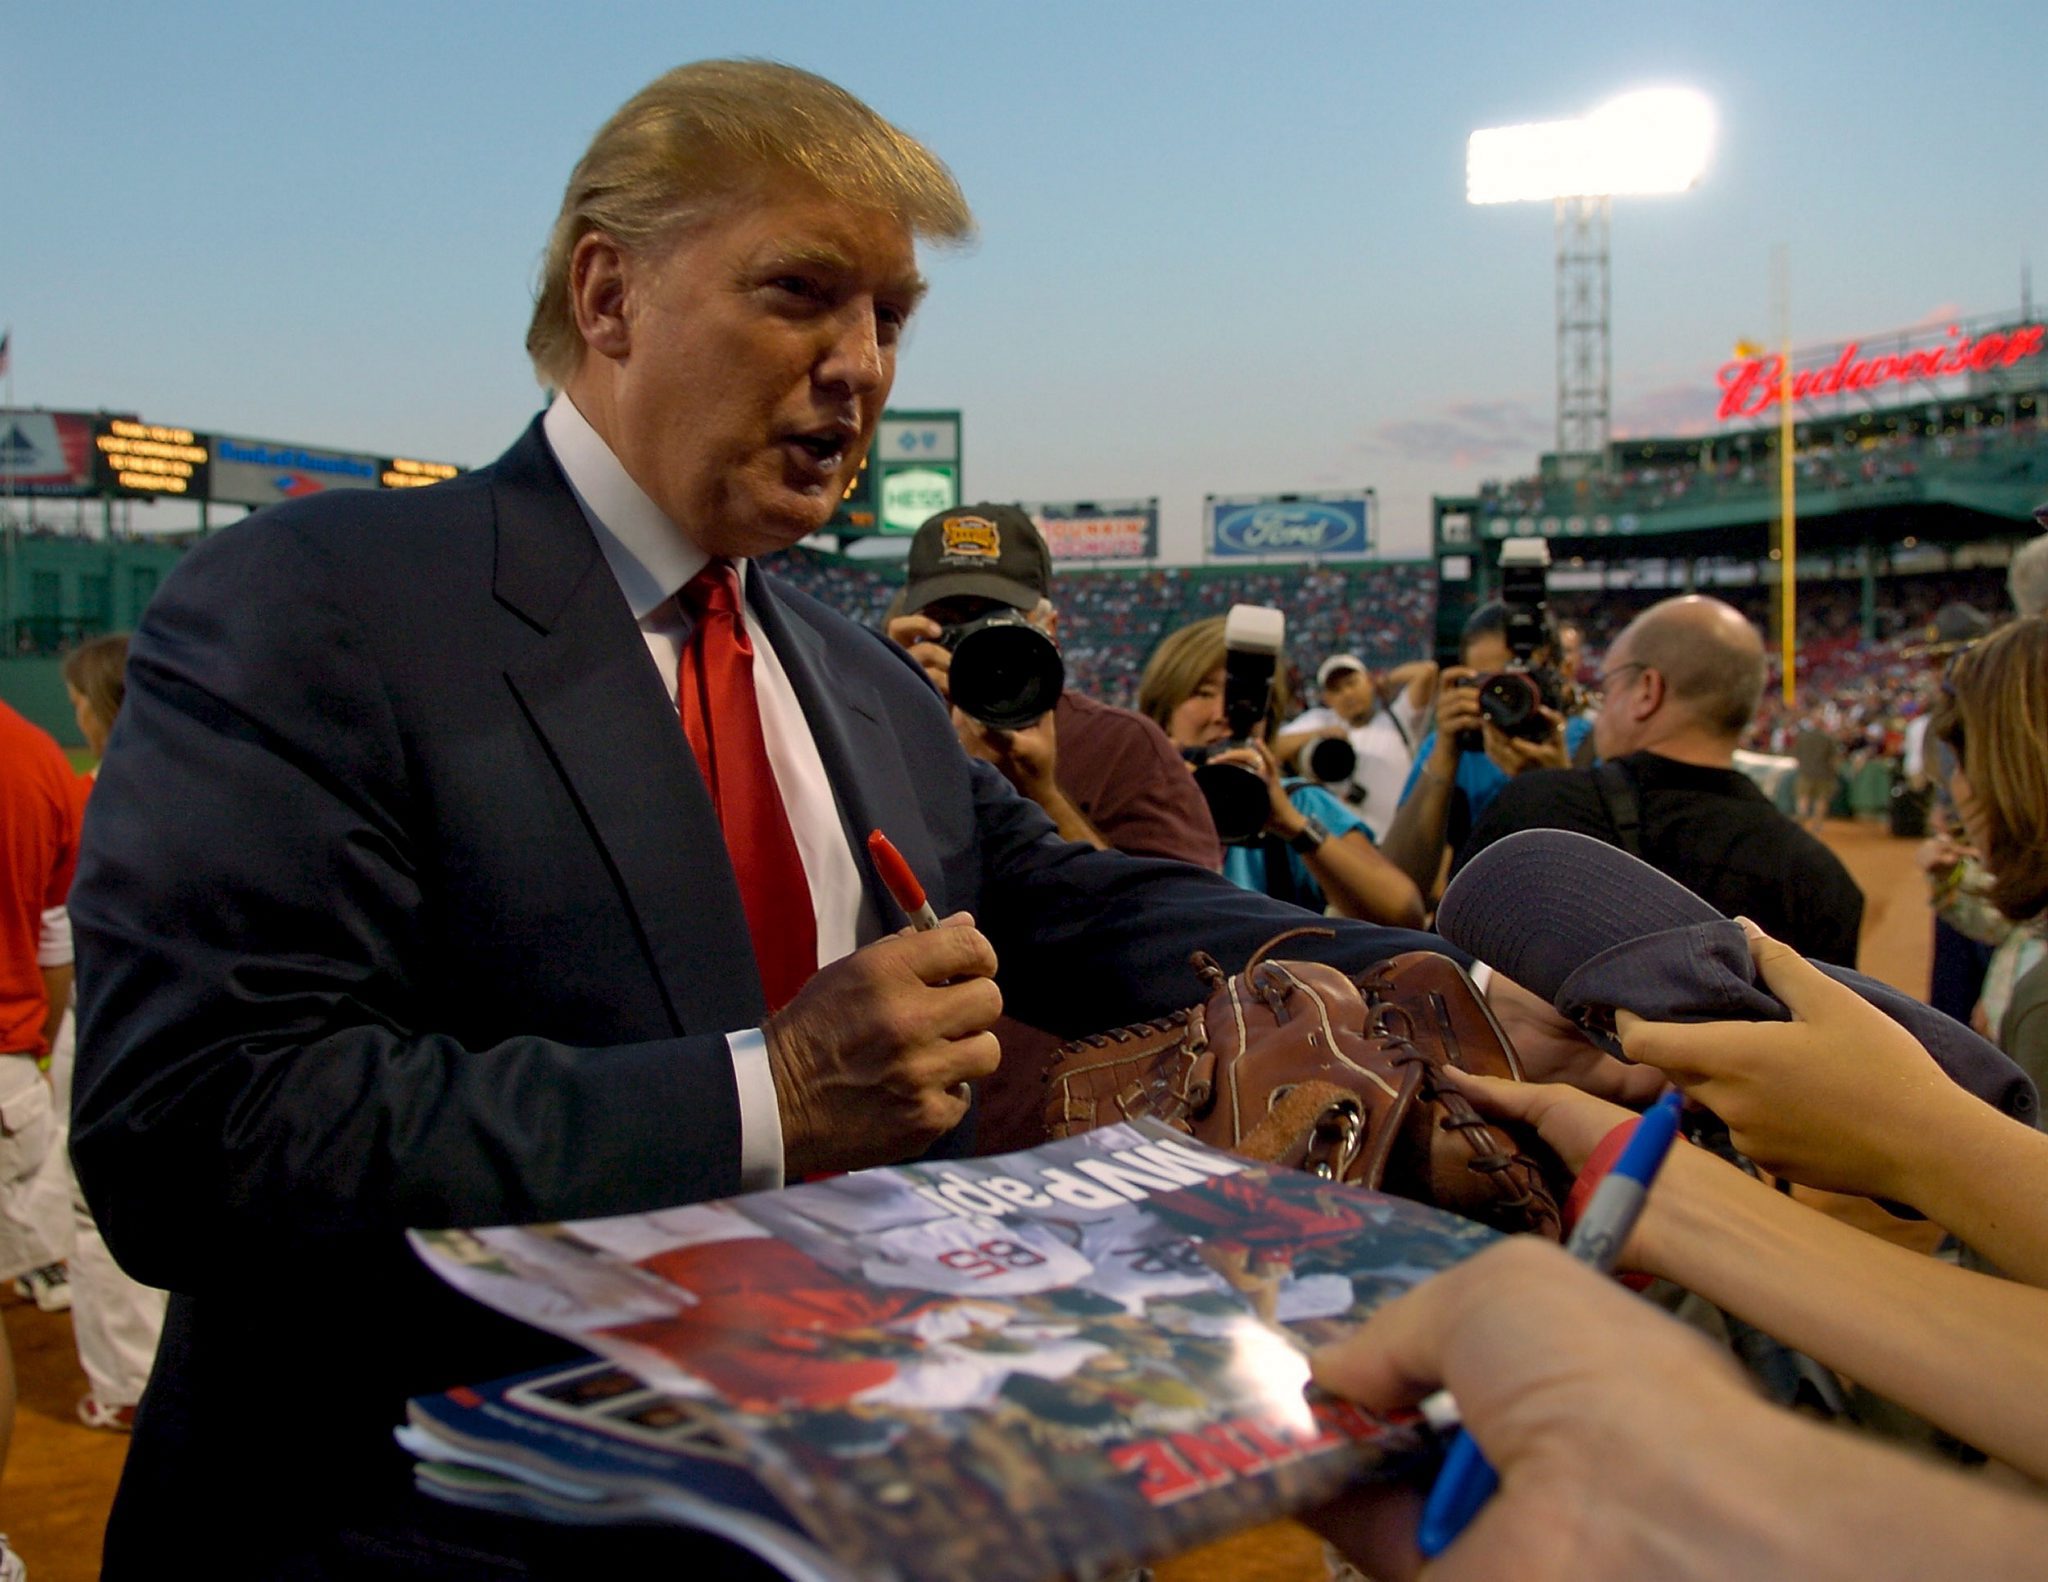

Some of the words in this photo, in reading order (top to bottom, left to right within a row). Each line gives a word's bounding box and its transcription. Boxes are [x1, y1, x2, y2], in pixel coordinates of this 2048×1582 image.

[1716, 323, 2045, 420] Budweiser
[888, 489, 945, 508] HESS
[1243, 509, 1329, 547] Ford
